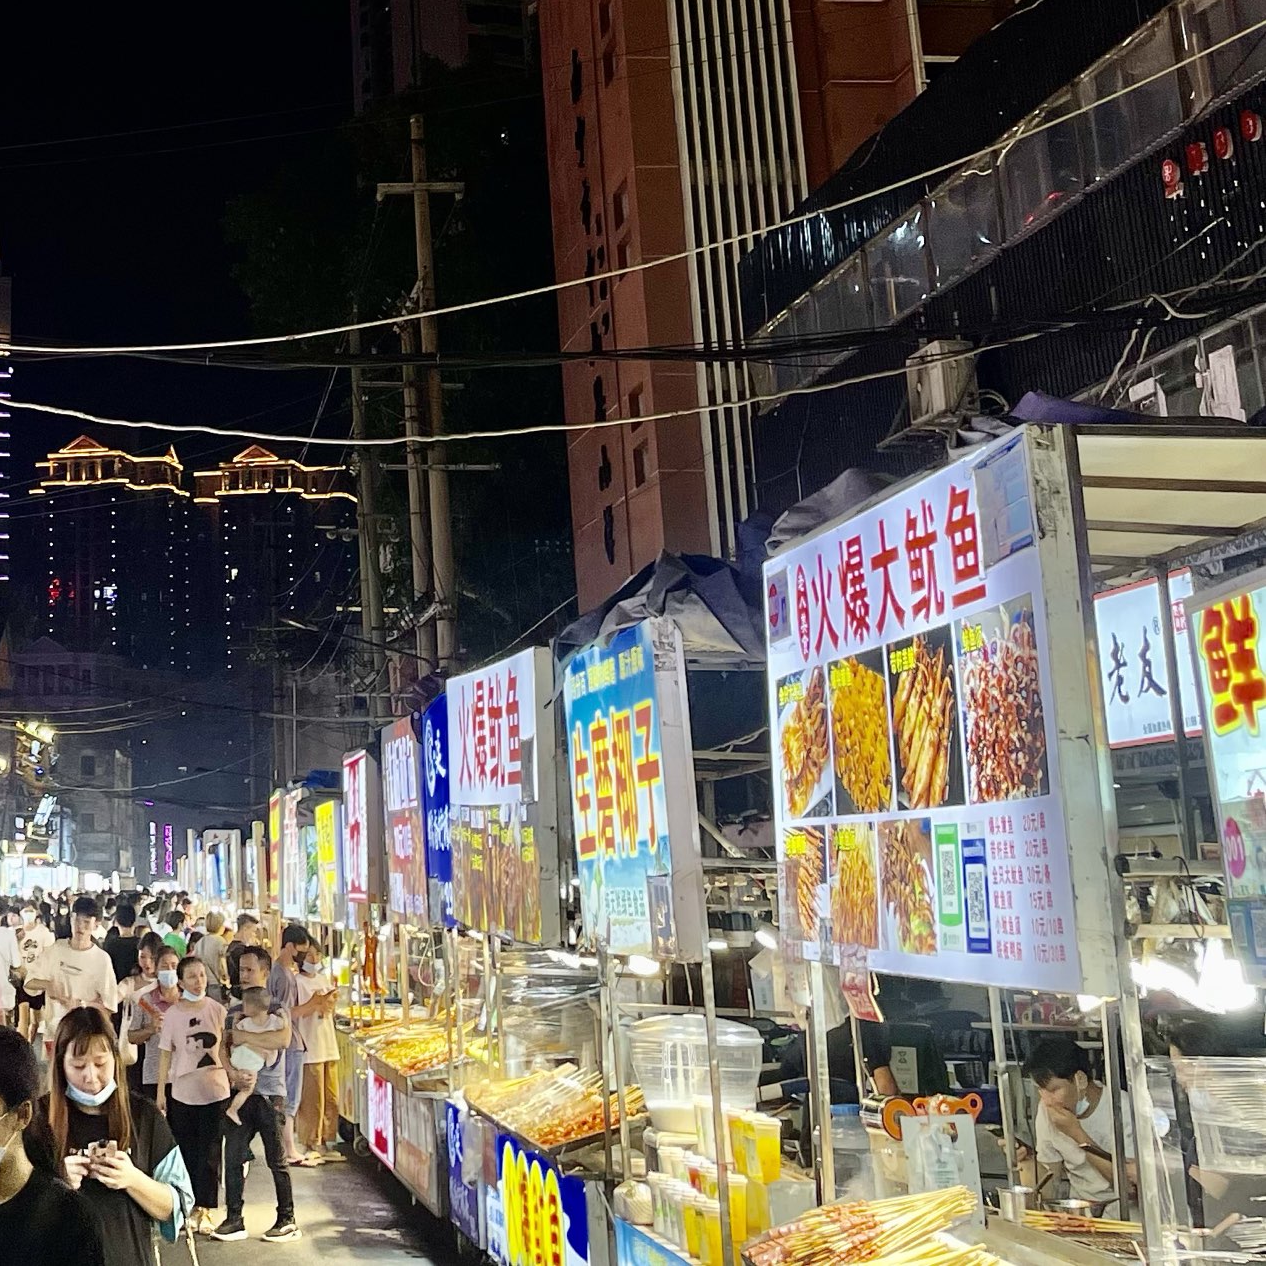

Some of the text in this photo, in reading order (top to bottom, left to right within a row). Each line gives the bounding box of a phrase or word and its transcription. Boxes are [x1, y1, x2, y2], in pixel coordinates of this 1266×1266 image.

[810, 485, 987, 658] 火爆大鱿鱼
[458, 668, 522, 790] 火爆鱿鱼
[1108, 625, 1167, 705] 老友
[573, 699, 661, 860] 生磨椰子
